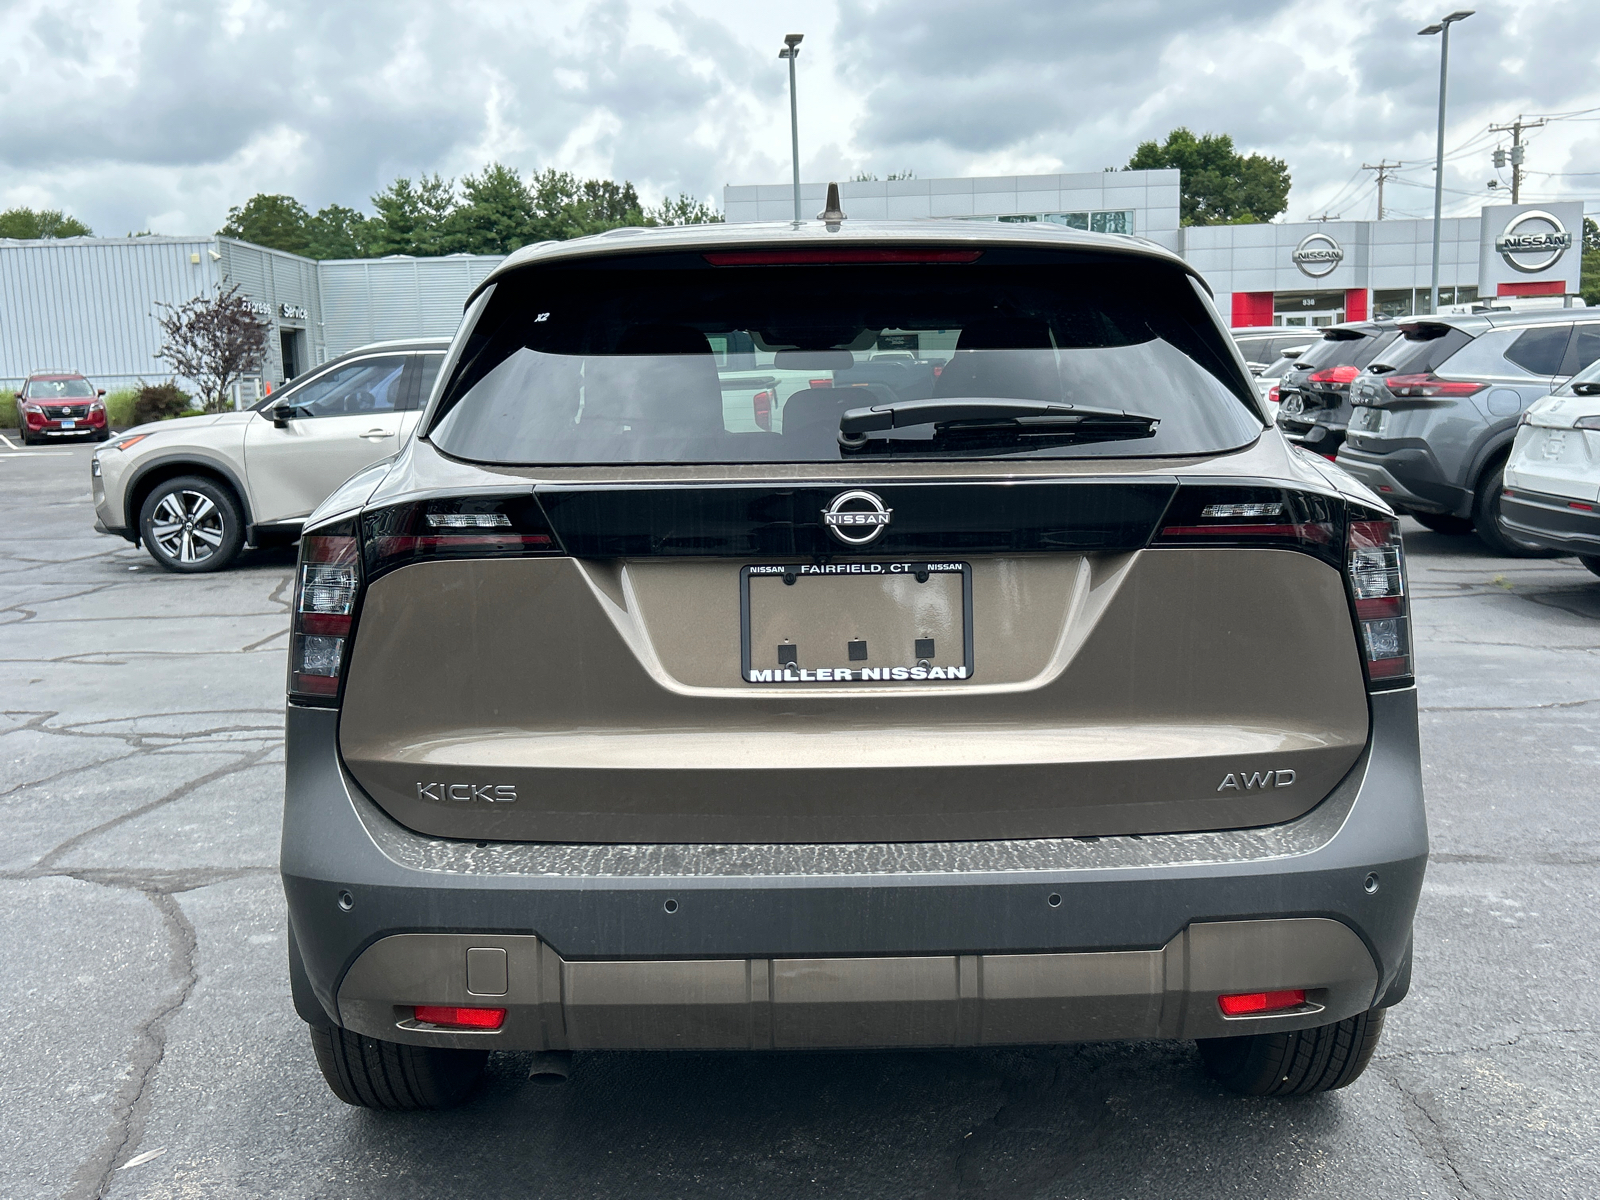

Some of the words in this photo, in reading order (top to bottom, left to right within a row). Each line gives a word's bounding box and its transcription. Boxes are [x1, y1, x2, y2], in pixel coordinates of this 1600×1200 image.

[1504, 236, 1565, 248] NISSAN
[1297, 251, 1340, 260] NISSAN
[825, 514, 890, 524] NISSAN
[801, 564, 885, 574] FAIRFIELD,
[890, 563, 911, 572] CT
[927, 563, 962, 571] NISSAN
[750, 668, 852, 682] MILLER
[861, 666, 966, 680] NISSAN
[1217, 769, 1297, 792] AWD
[416, 782, 518, 802] KICKS
